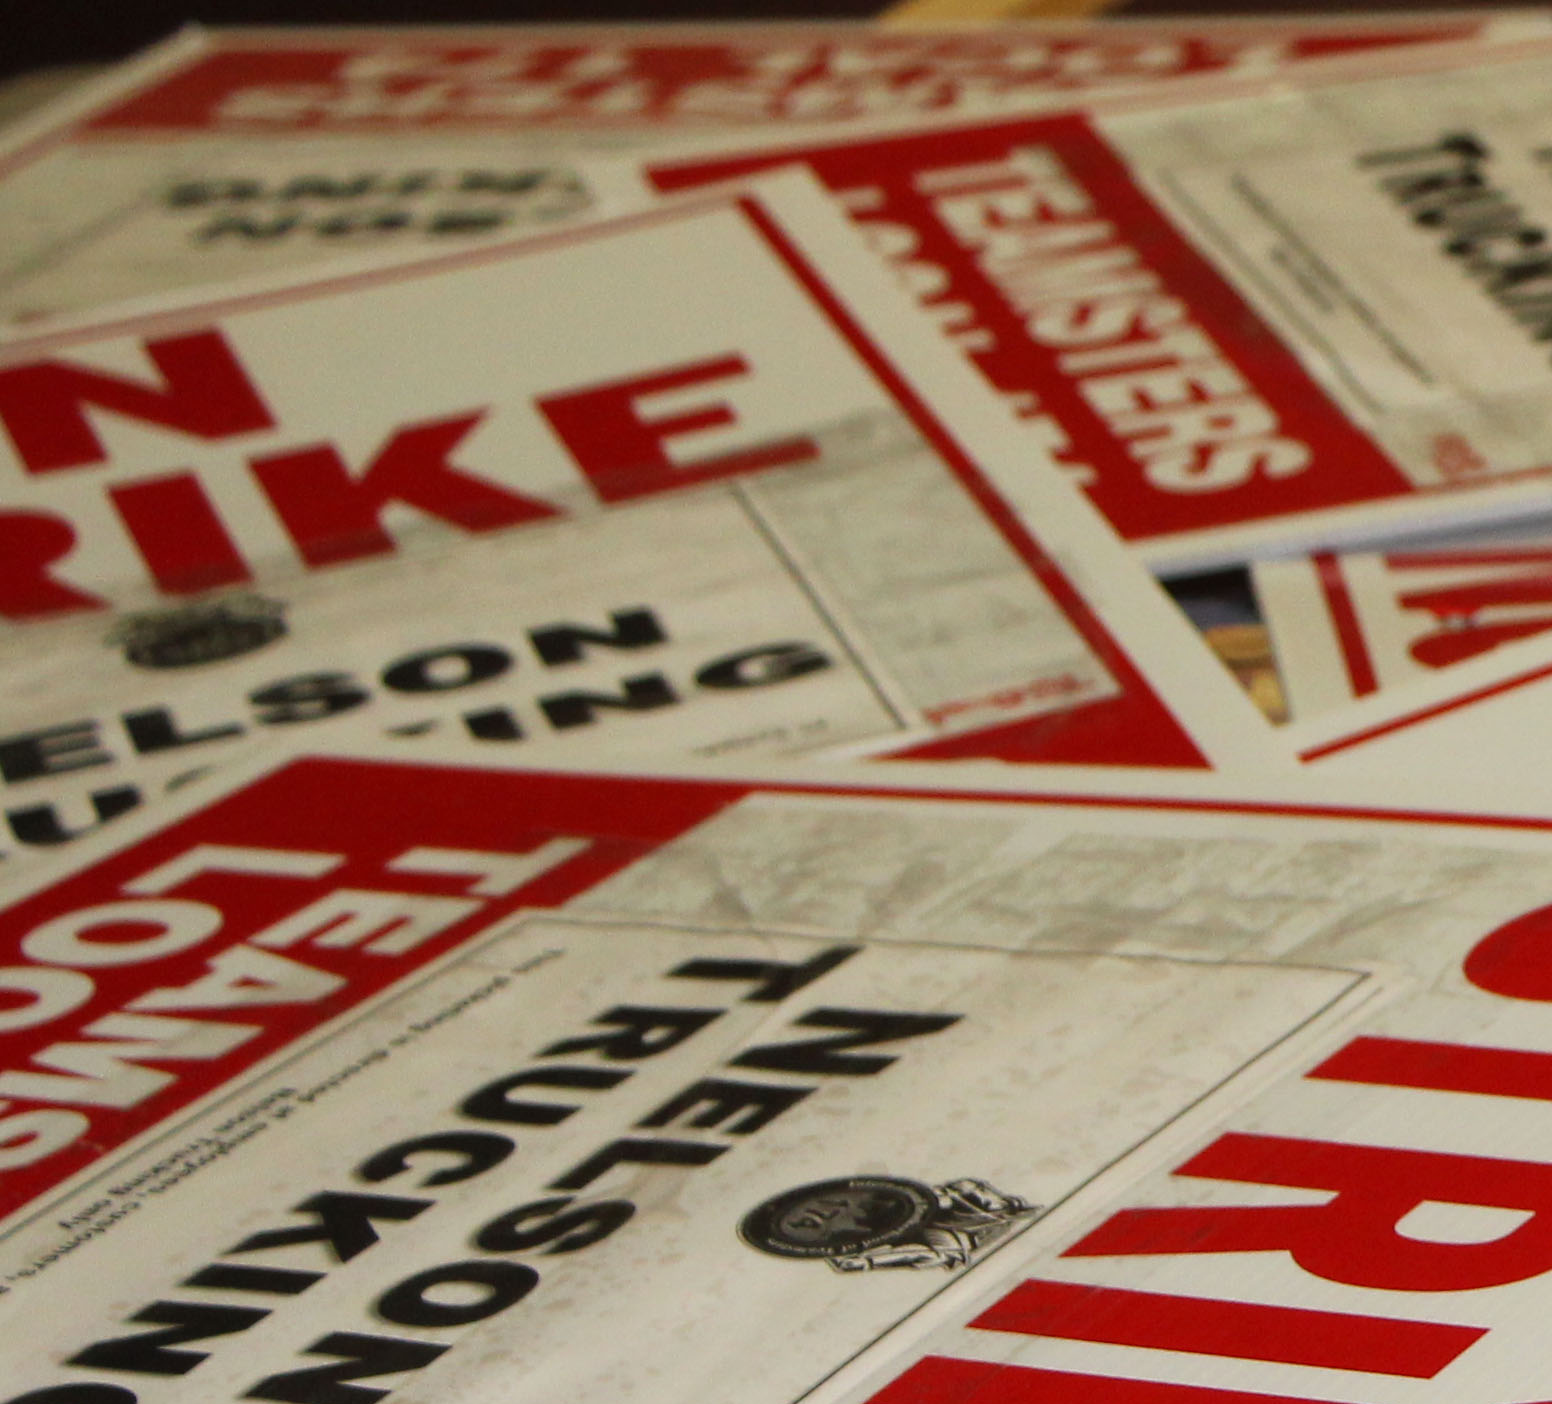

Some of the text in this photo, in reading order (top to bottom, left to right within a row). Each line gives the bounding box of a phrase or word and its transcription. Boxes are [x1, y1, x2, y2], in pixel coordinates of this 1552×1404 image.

[0, 326, 278, 476] N
[912, 144, 1312, 495] TEAMSTERS
[0, 606, 668, 784] ELSON
